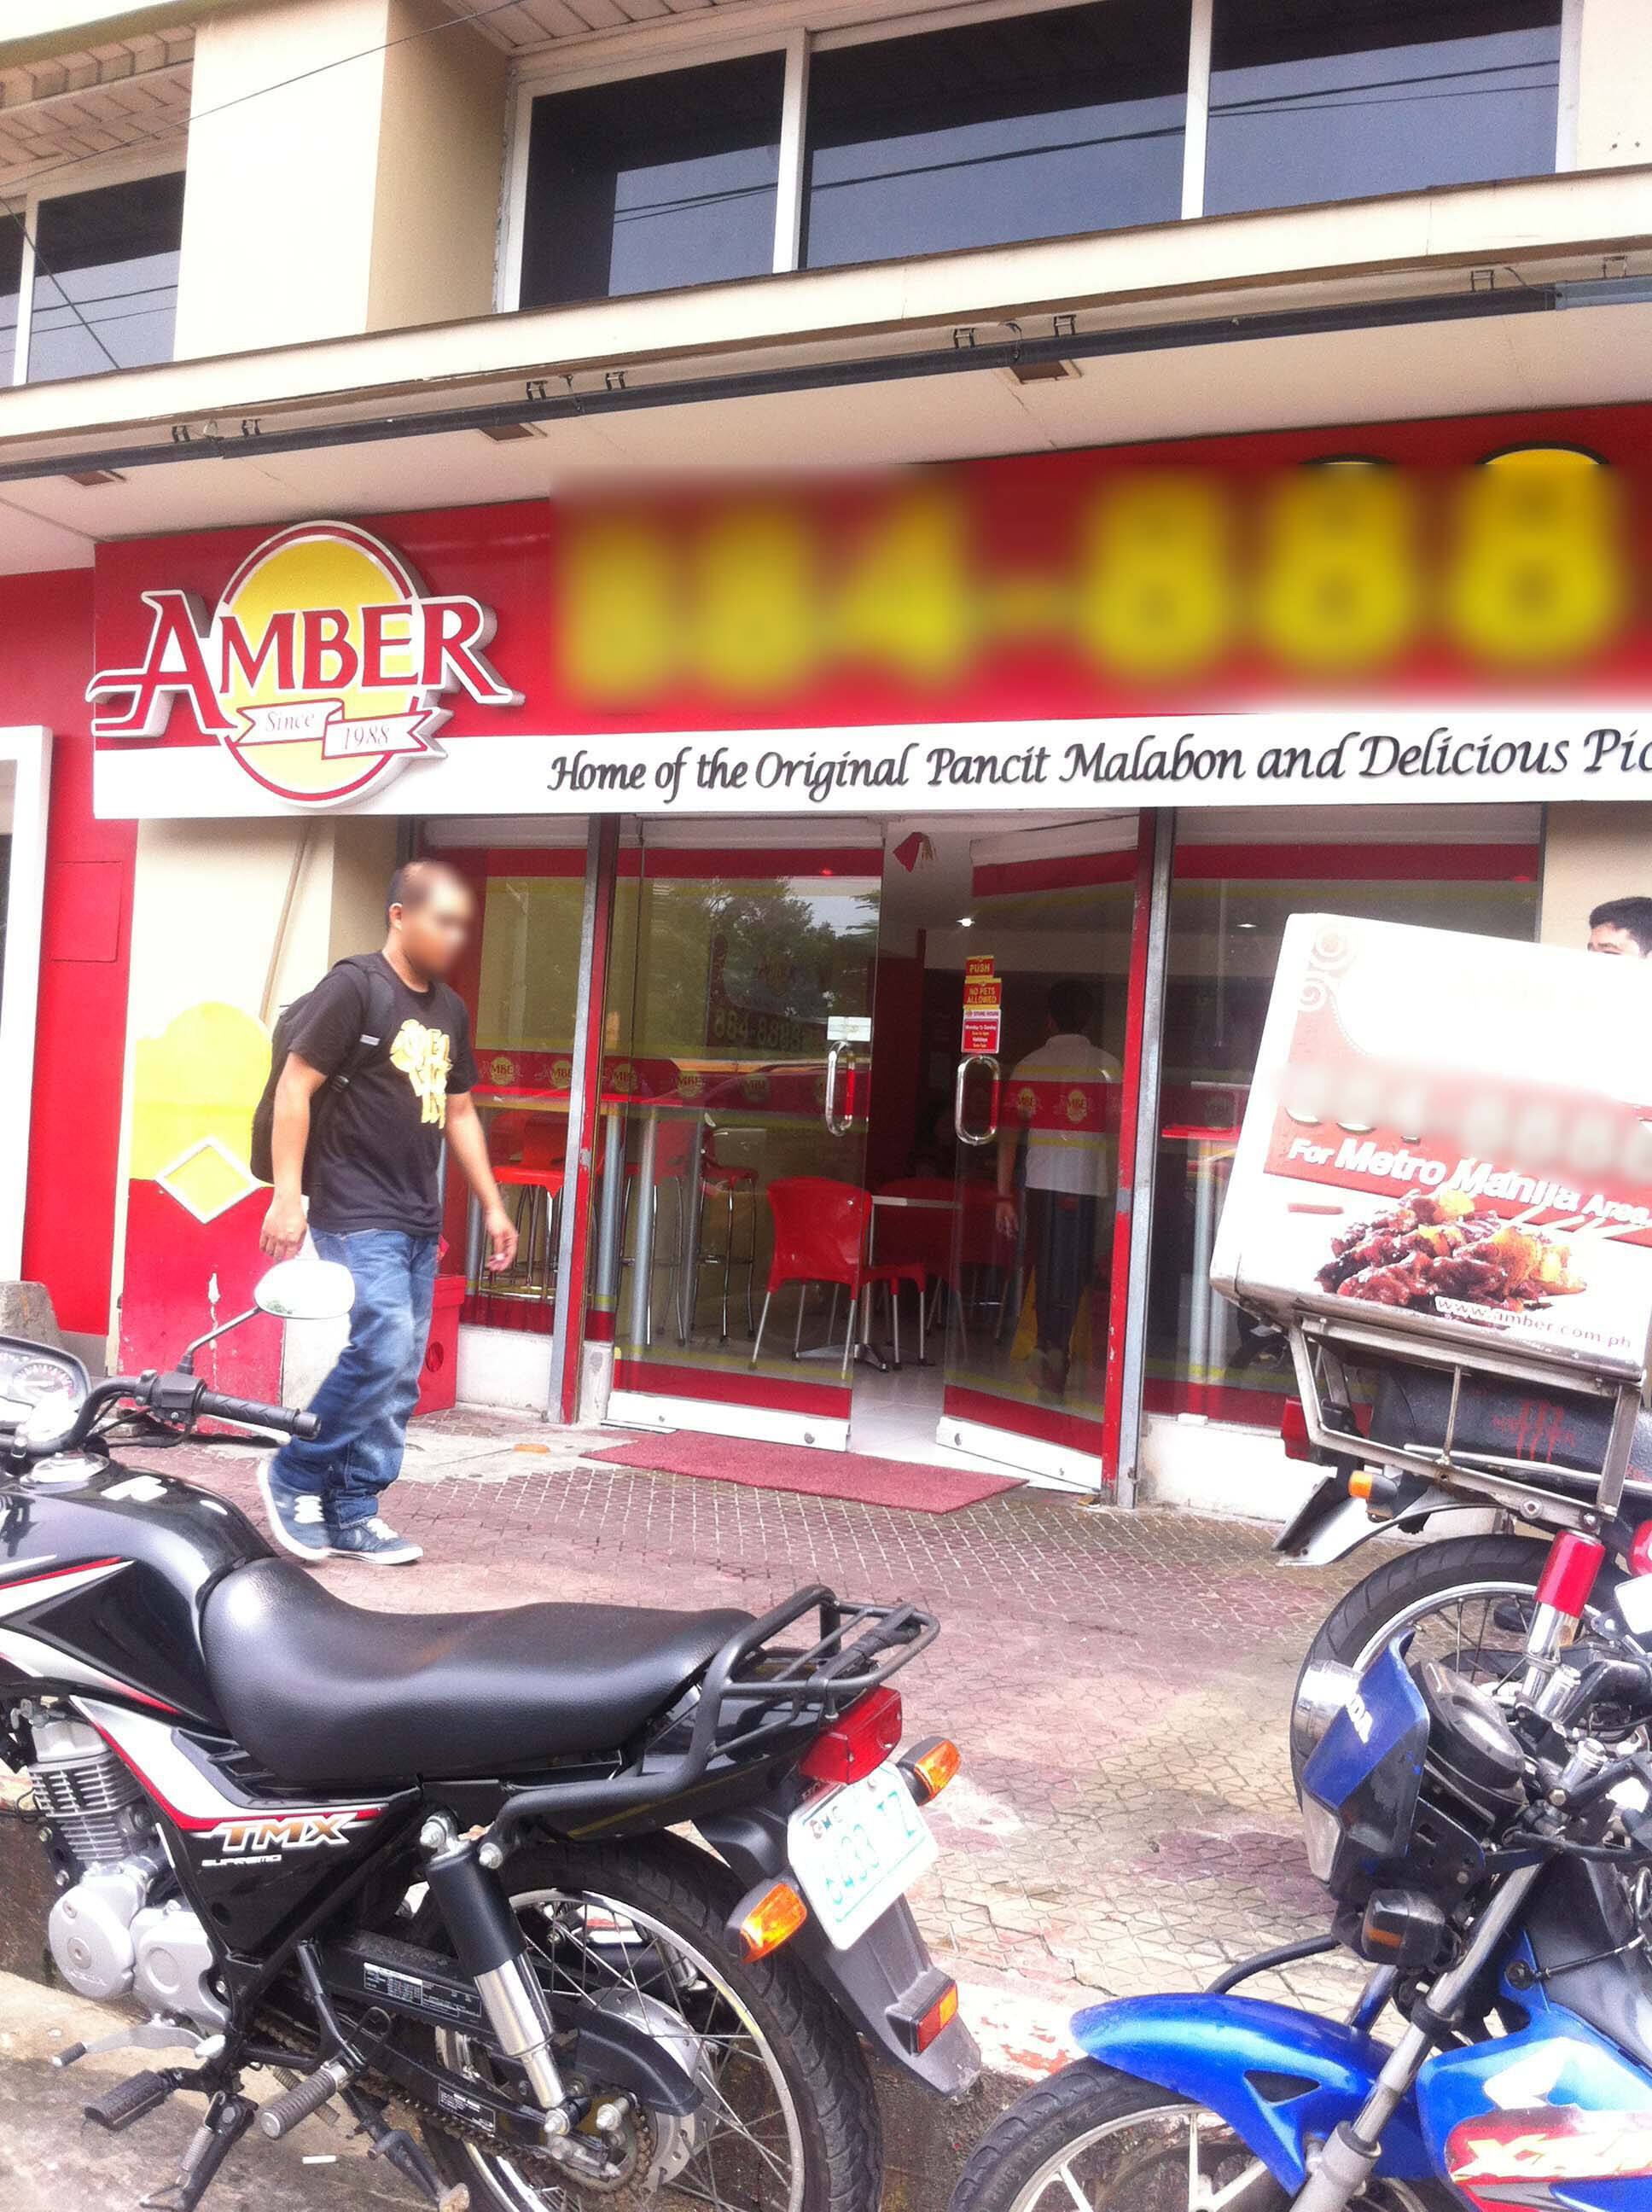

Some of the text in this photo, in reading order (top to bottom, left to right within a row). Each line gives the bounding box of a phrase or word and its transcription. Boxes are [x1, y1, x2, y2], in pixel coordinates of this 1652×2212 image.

[88, 591, 515, 732] AMBER
[265, 709, 390, 751] Since 1988
[548, 751, 646, 790] Home
[655, 747, 692, 803] of
[697, 748, 747, 789] the
[756, 743, 919, 802] Original
[927, 747, 1050, 785] Pancit
[1059, 734, 1246, 782] Malabon
[1258, 732, 1361, 779] and
[1358, 727, 1569, 778] Delicious
[969, 963, 991, 973] PUSH
[967, 996, 997, 1004] ALLOWED
[1289, 1138, 1335, 1164] For
[1335, 1138, 1446, 1185] Metro
[1452, 1158, 1580, 1213] Manila
[215, 1813, 358, 1852] TMX
